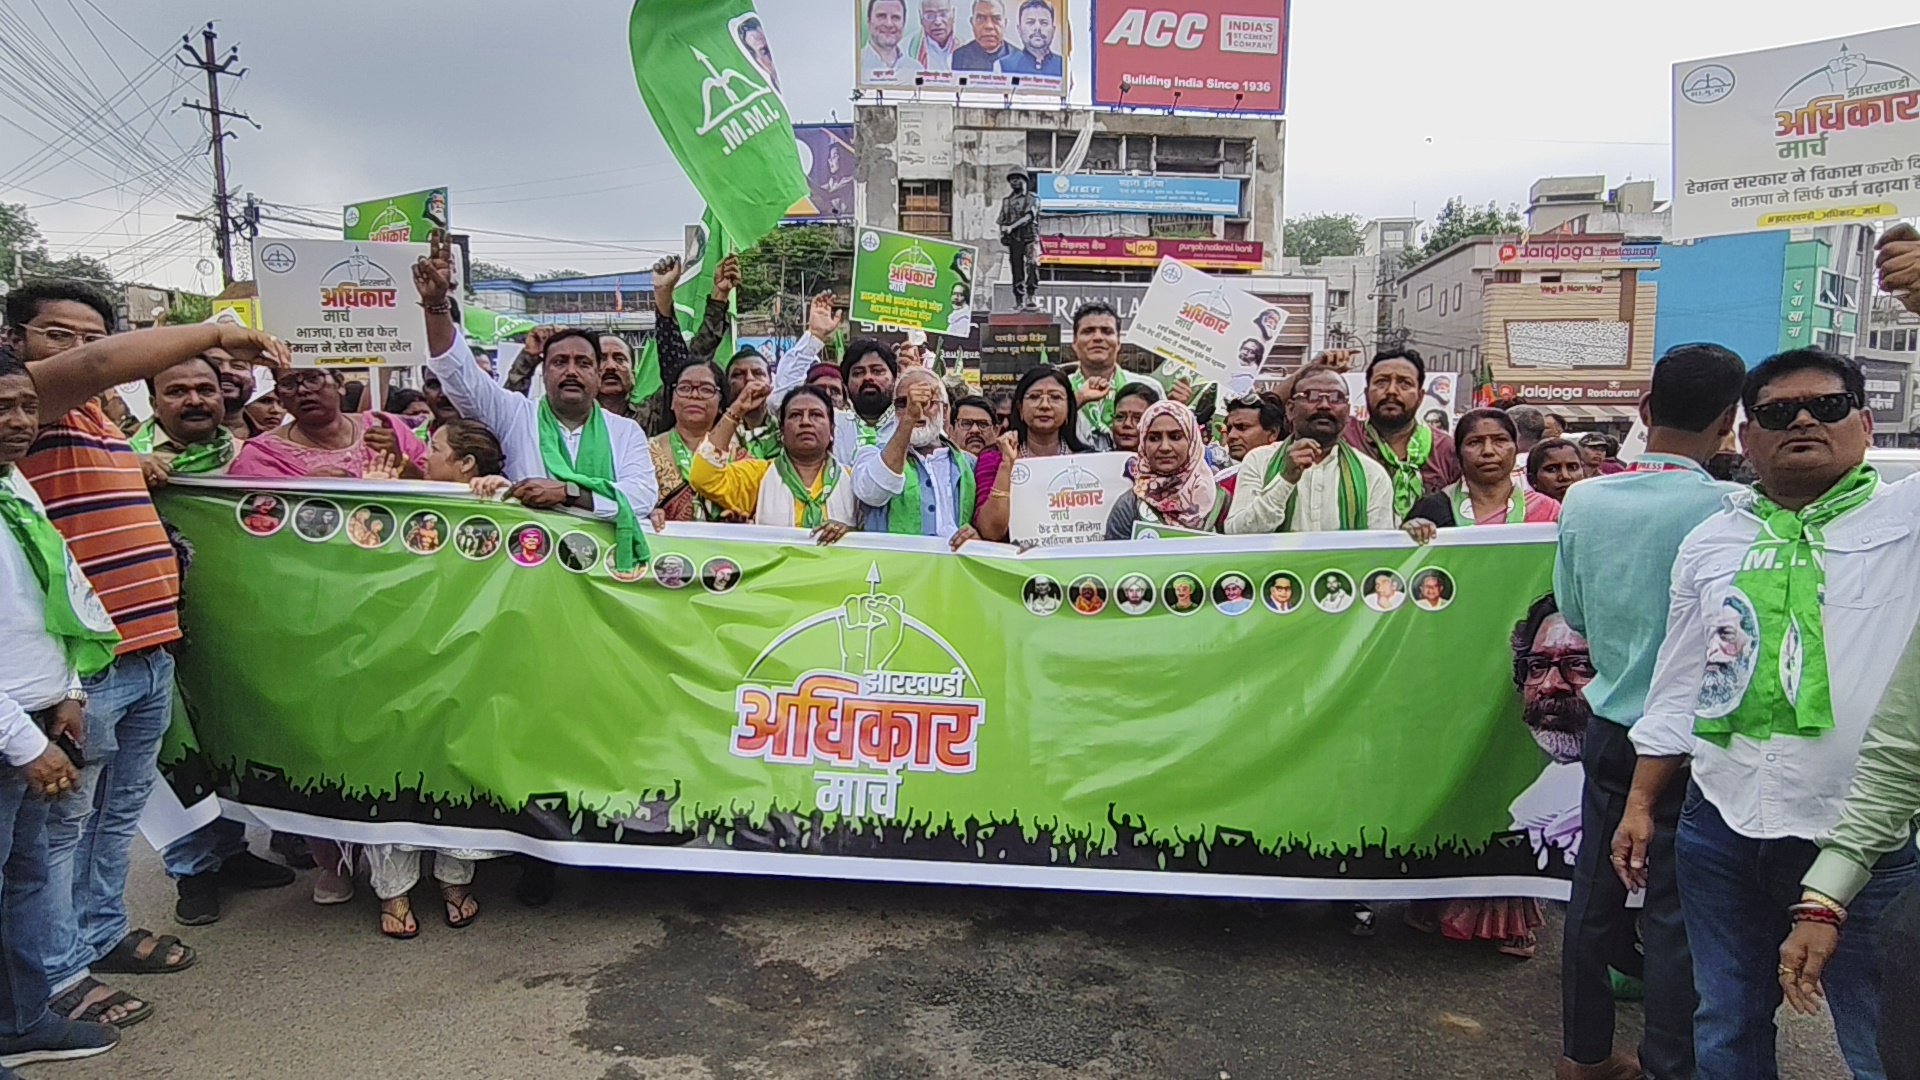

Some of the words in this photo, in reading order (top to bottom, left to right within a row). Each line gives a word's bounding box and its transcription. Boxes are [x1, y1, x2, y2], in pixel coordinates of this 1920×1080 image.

[1104, 8, 1208, 50] ACC
[1228, 21, 1274, 33] INDIA'S
[1233, 41, 1273, 49] COMPANY
[1243, 33, 1273, 41] CEMENT
[1122, 73, 1171, 88] Building
[1174, 76, 1204, 89] India
[1206, 78, 1239, 92] Since
[1242, 80, 1271, 93] 1936
[1846, 76, 1911, 98] झारखण्डी
[1774, 90, 1920, 137] अधिकार
[1776, 131, 1829, 160] मार्च
[1685, 178, 1729, 196] हेमन्त
[1731, 172, 1787, 190] सरकार
[1791, 167, 1806, 183] ने
[1810, 163, 1863, 182] विकास
[1865, 157, 1904, 176] करके
[1731, 190, 1774, 208] भाजपा
[1776, 188, 1791, 204] ने
[1794, 185, 1824, 204] सिर्फ
[1828, 180, 1859, 199] कर्ज
[1862, 177, 1910, 198] बढ़ाया
[1138, 244, 1156, 253] pnb
[1178, 242, 1203, 252] punjab
[1204, 243, 1234, 252] national
[1235, 243, 1254, 253] bank
[1520, 245, 1594, 261] Jalajoga
[1600, 246, 1658, 260] Restaurant
[889, 264, 937, 287] अधिकार
[321, 282, 395, 308] अधिकार
[1540, 285, 1557, 295] Veg
[1586, 285, 1604, 295] Veg
[322, 306, 351, 323] मार्च
[1179, 302, 1231, 335] अधिकार
[1174, 315, 1195, 332] मार्च
[296, 327, 336, 340] भाजपा,
[339, 327, 354, 338] ED
[355, 327, 374, 338] सब
[376, 325, 399, 338] फेल
[321, 341, 333, 353] ने
[335, 341, 363, 353] खेला
[366, 340, 387, 352] ऐसा
[389, 339, 412, 352] खेल
[1517, 385, 1583, 400] Jalajoga
[1587, 387, 1640, 398] Restaurant
[1637, 462, 1662, 470] PRESS
[1047, 488, 1104, 509] अधिकार
[1049, 508, 1071, 521] मार्च
[1075, 521, 1102, 533] मिलेगा
[864, 667, 966, 697] झारखण्डी
[731, 670, 985, 774] अधिकार
[814, 763, 907, 819] मार्च
